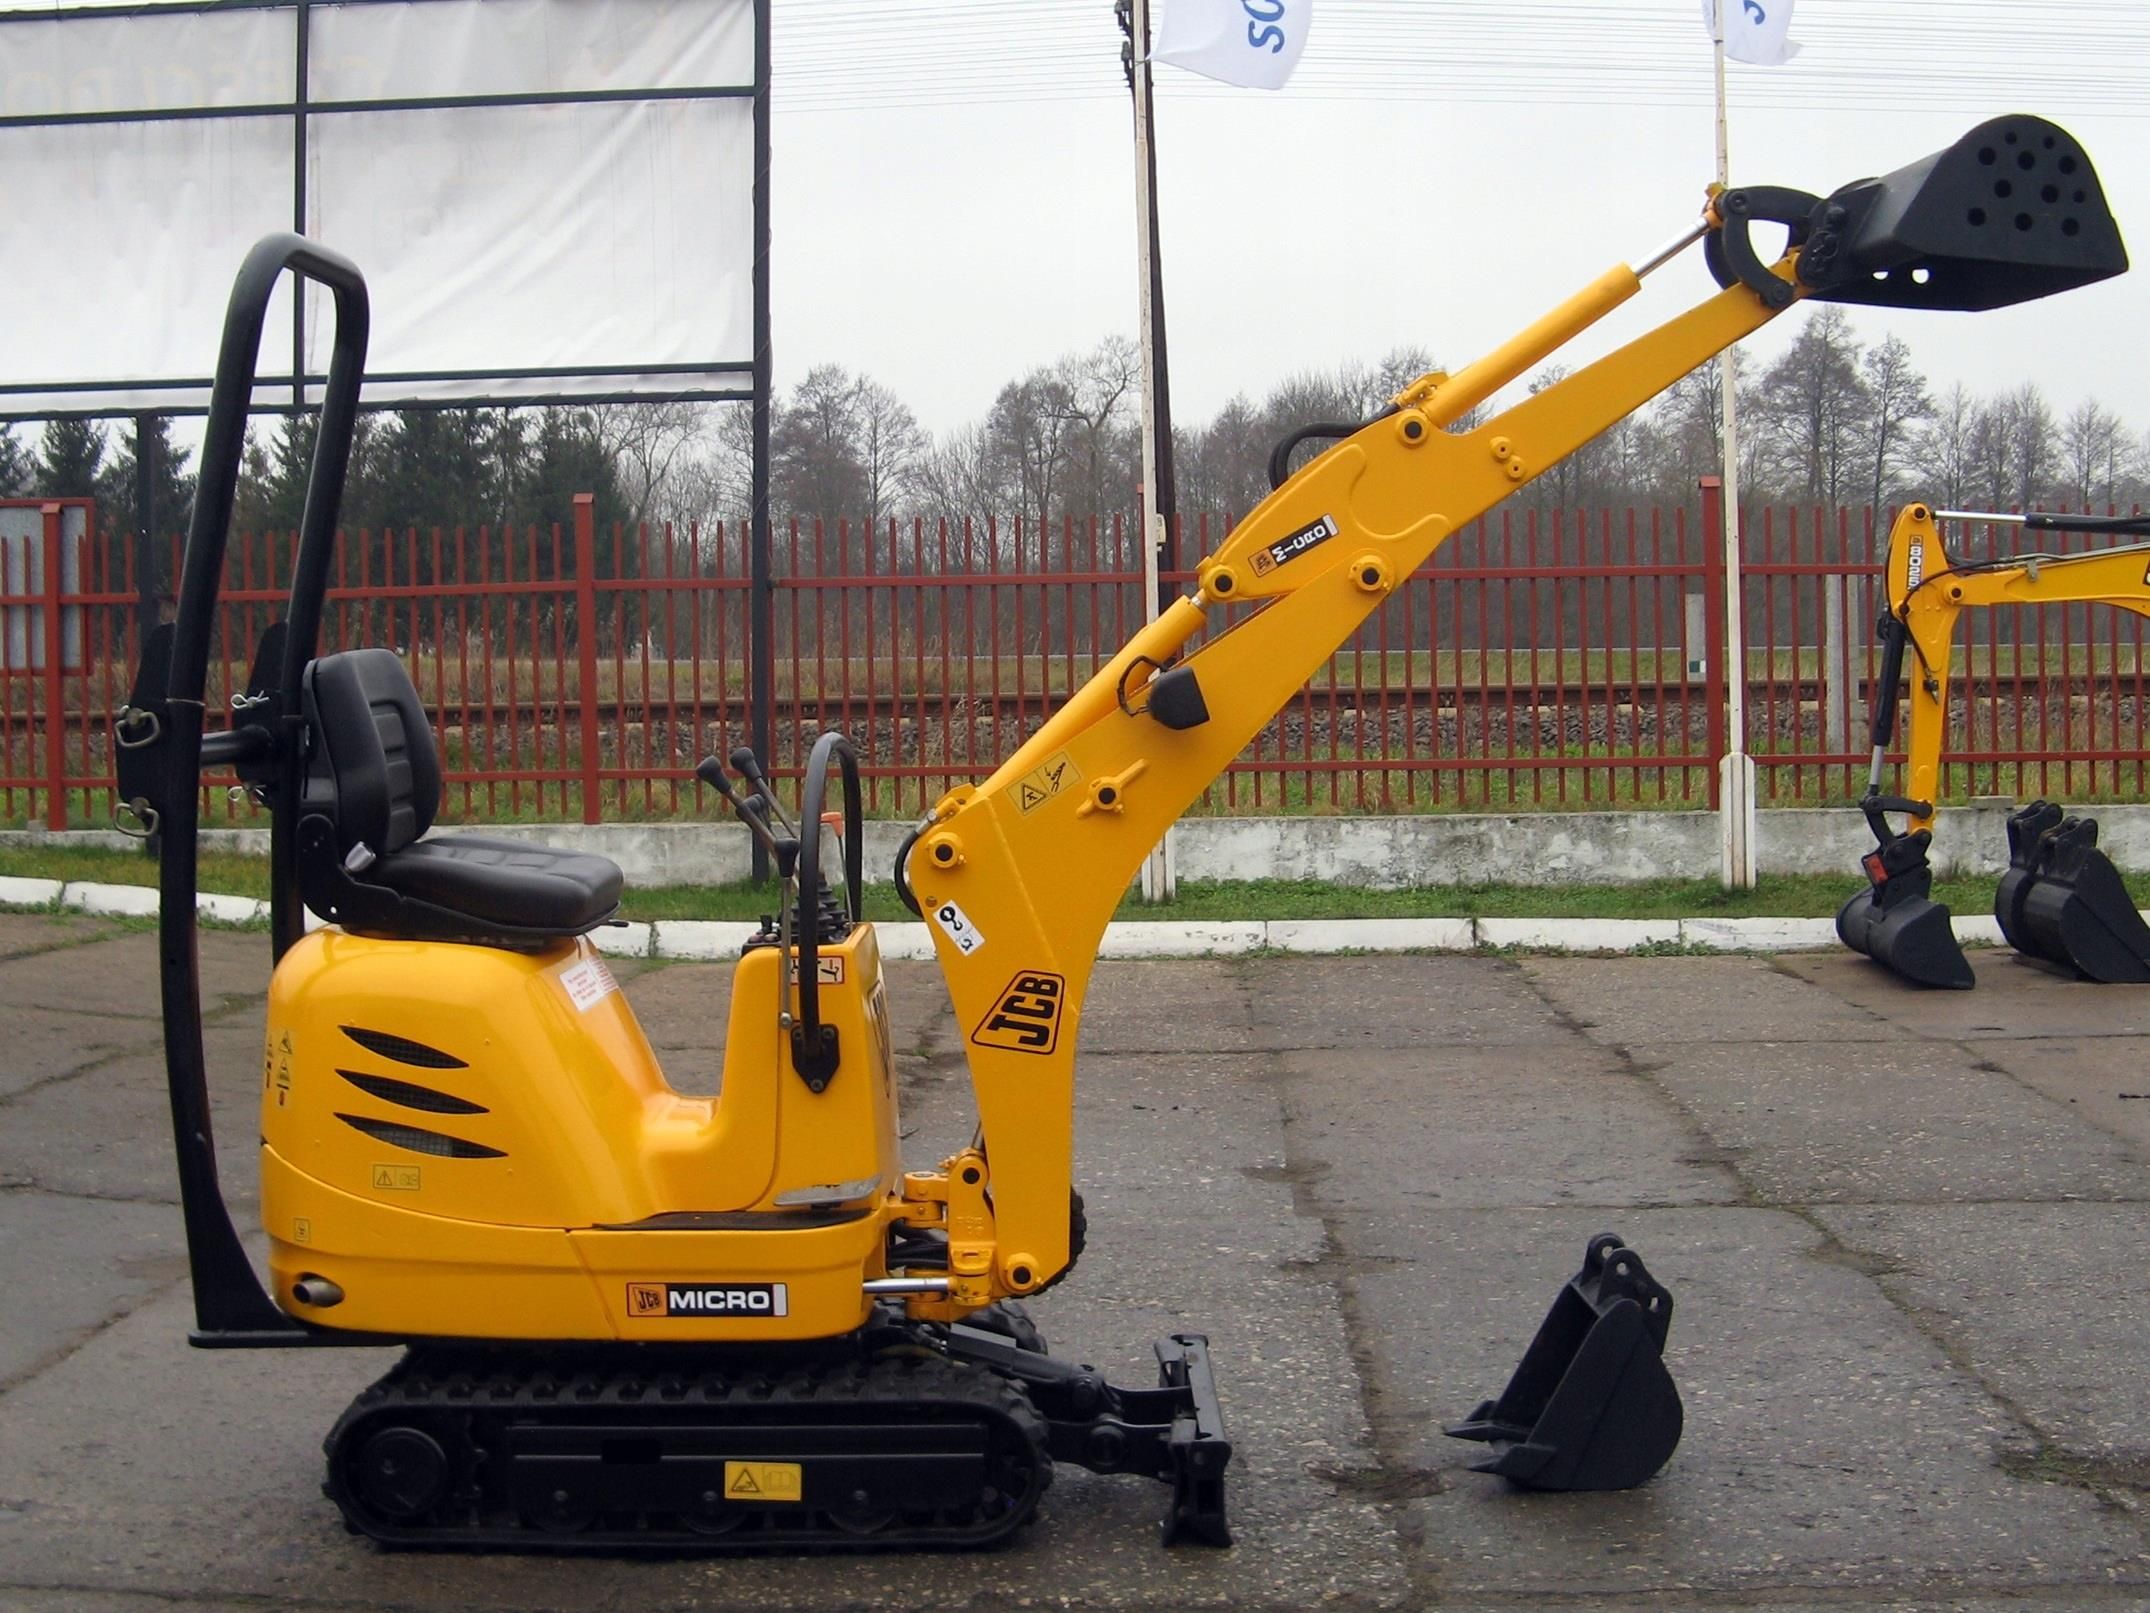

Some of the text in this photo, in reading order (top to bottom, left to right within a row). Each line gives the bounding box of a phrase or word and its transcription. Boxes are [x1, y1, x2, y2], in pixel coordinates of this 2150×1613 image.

[1271, 524, 1327, 562] MICRO
[986, 976, 1059, 1047] JCB
[638, 1289, 770, 1310] JCB MICRO
